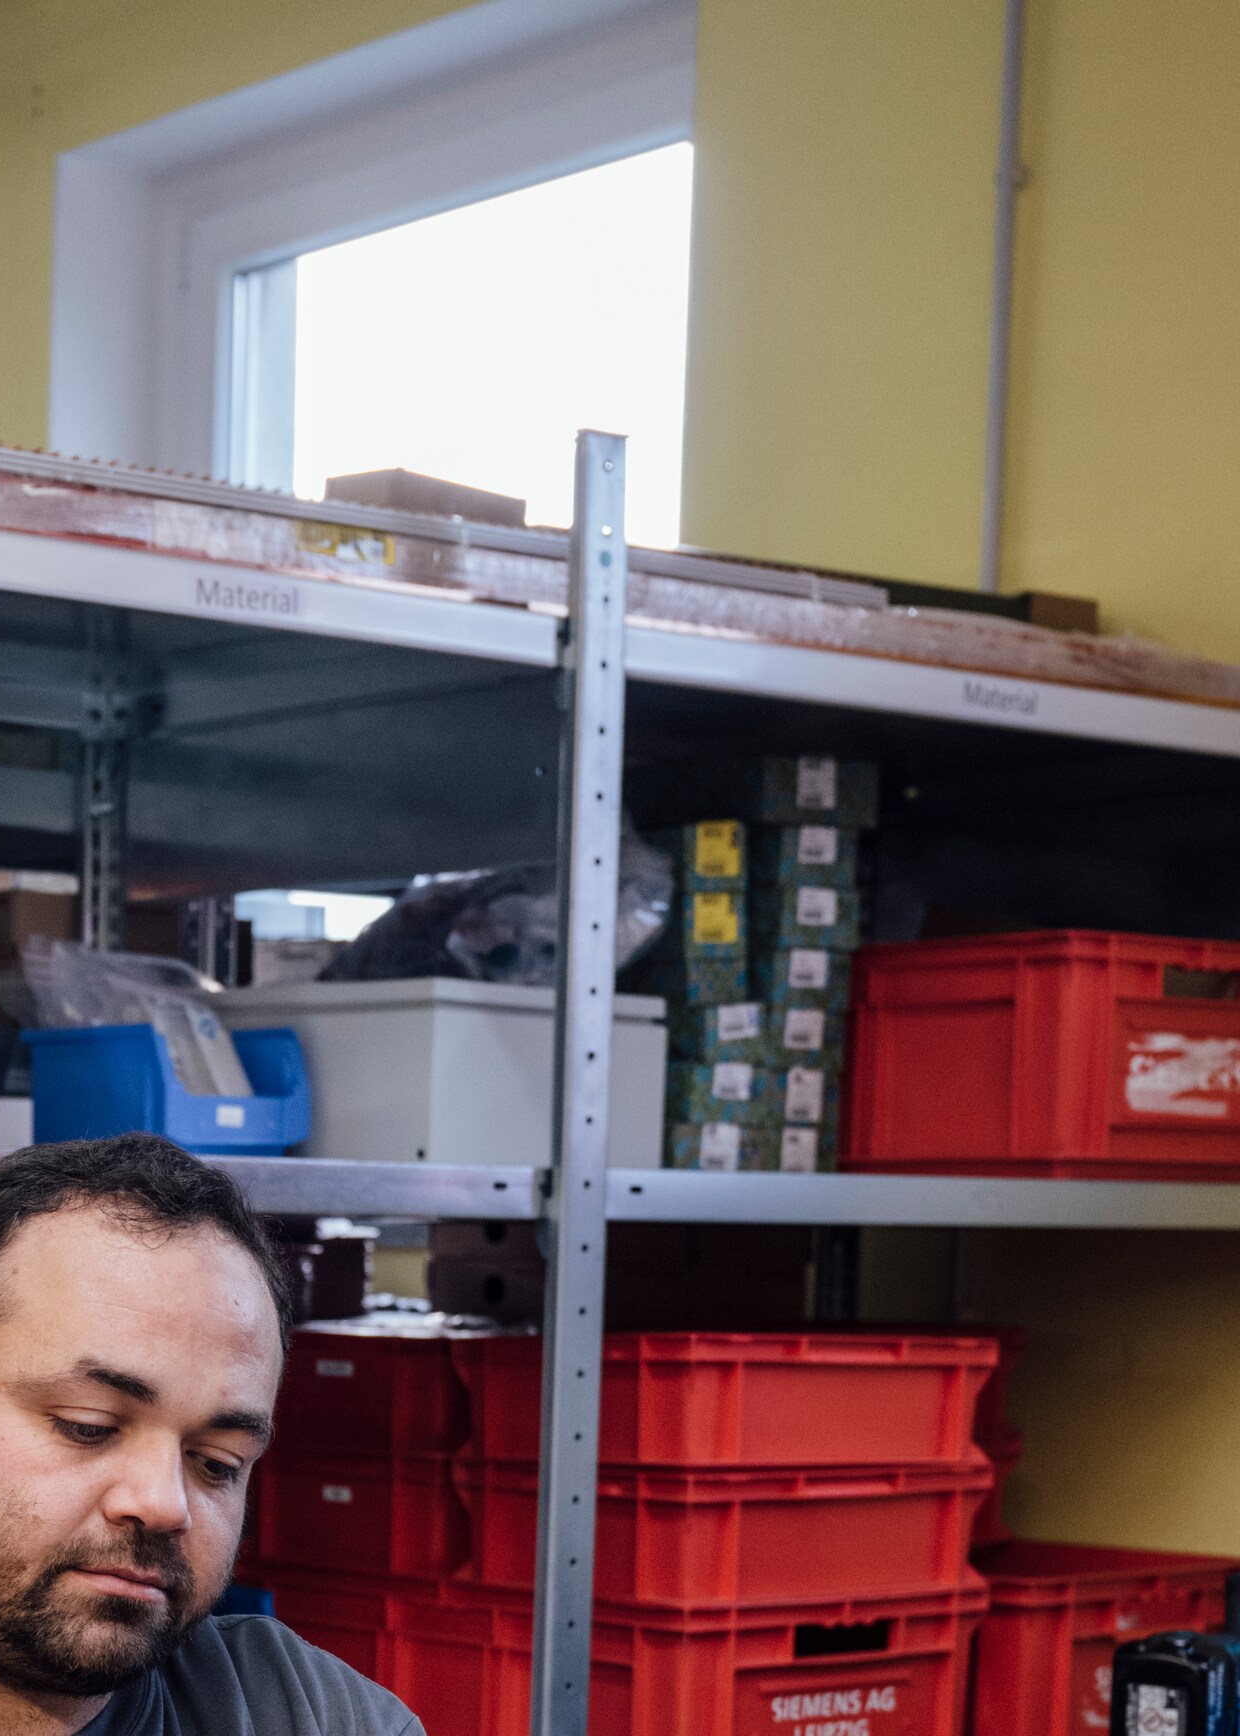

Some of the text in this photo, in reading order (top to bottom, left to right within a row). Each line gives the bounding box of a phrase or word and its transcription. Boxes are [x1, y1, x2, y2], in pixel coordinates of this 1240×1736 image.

[196, 577, 300, 615] Material
[772, 1686, 896, 1722] SIEMENS AG
